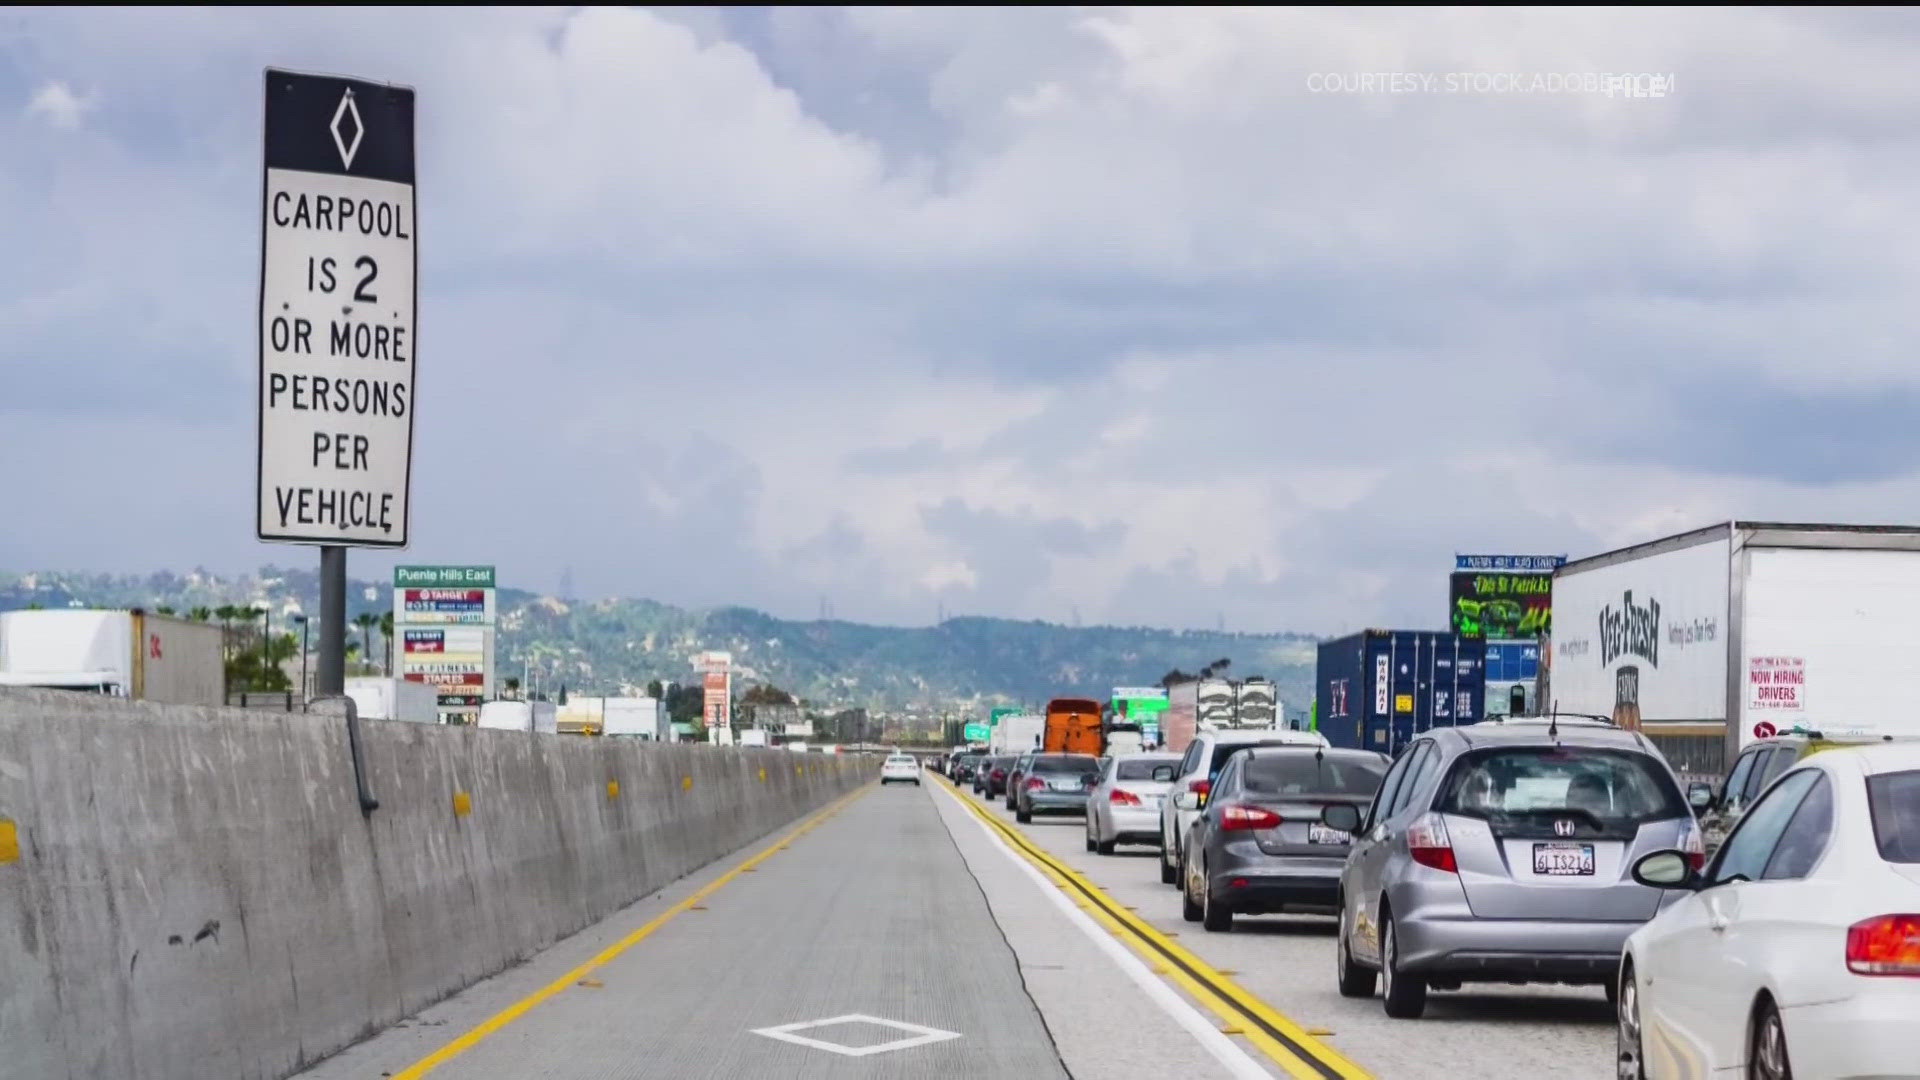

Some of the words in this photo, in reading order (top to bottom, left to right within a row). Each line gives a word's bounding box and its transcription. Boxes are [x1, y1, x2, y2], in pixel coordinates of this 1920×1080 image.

[273, 191, 409, 240] CARPOOL
[309, 256, 337, 294] IS
[353, 255, 378, 303] 2
[271, 316, 312, 354] OR
[330, 320, 406, 362] MORE
[269, 373, 406, 418] PERSONS
[313, 432, 369, 471] PER
[276, 486, 393, 530] VEHICLE
[398, 569, 437, 581] Puente
[440, 569, 463, 581] Hills
[466, 569, 490, 581] East
[431, 590, 468, 600] TARGET
[412, 664, 425, 673] LA
[429, 664, 476, 673] FITNESS
[423, 674, 464, 684] STAPLES
[1378, 659, 1387, 681] WAN
[1751, 670, 1771, 684] NOW
[1774, 671, 1803, 684] HIRING
[1378, 688, 1386, 710] HAI
[1758, 687, 1796, 700] DRIVERS
[1538, 855, 1591, 870] 6LIS216
